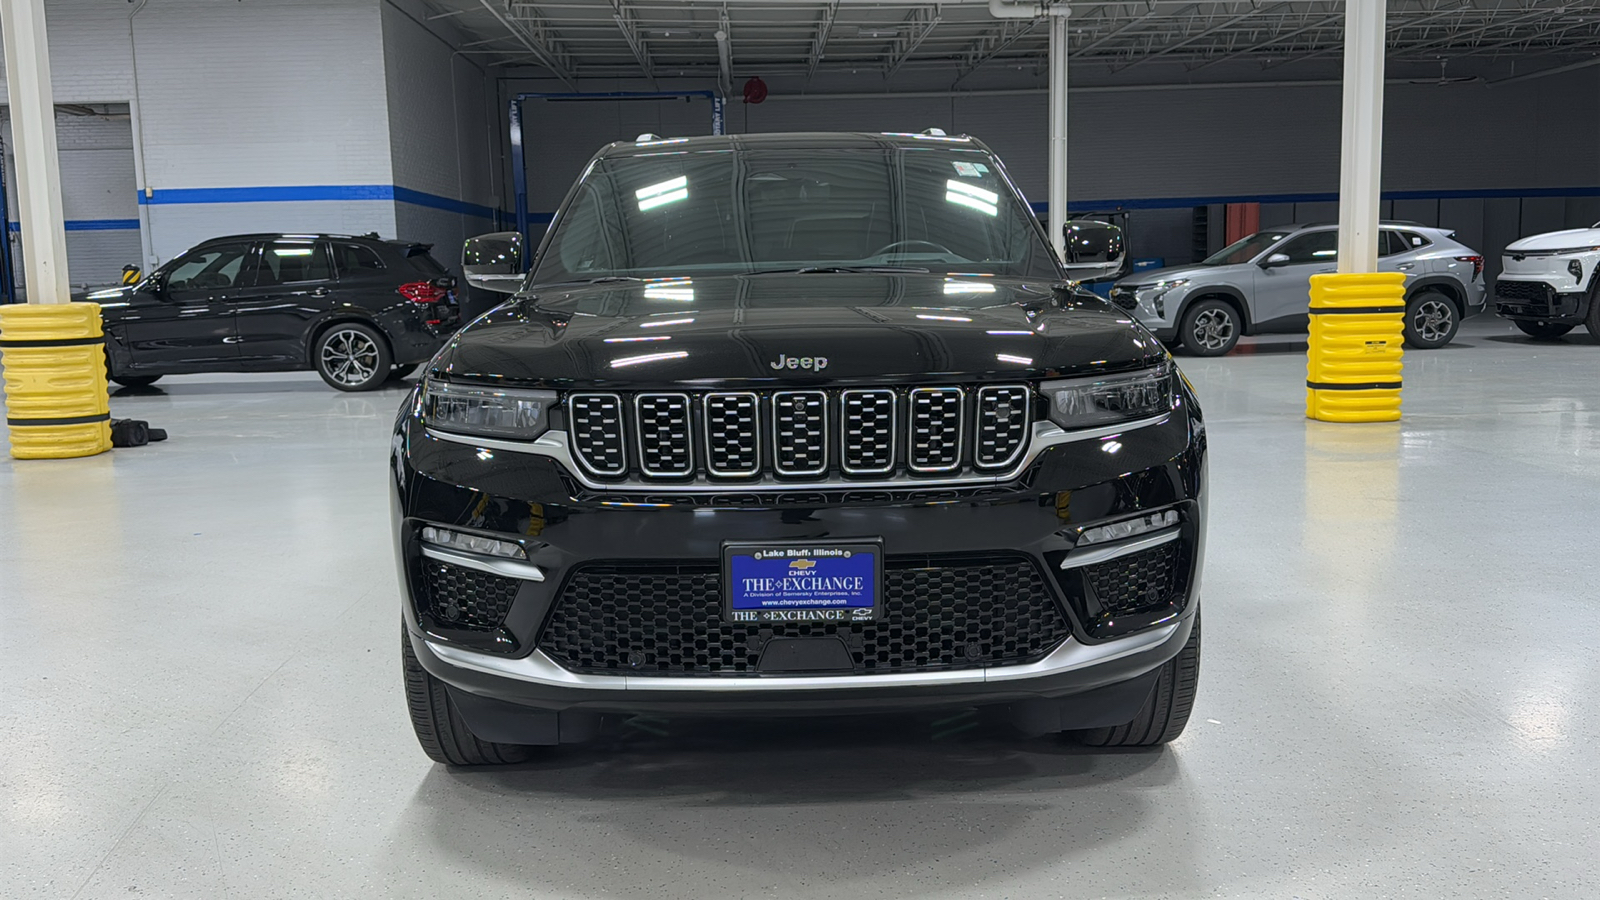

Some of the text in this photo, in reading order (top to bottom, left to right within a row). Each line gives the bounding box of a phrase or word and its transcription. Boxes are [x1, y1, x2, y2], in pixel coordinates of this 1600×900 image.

[770, 354, 828, 372] Jeep
[763, 548, 843, 557] Lake Bluff, Illinois
[742, 577, 864, 591] THE EXCHANGE
[731, 610, 845, 621] THE EXCHANGE
